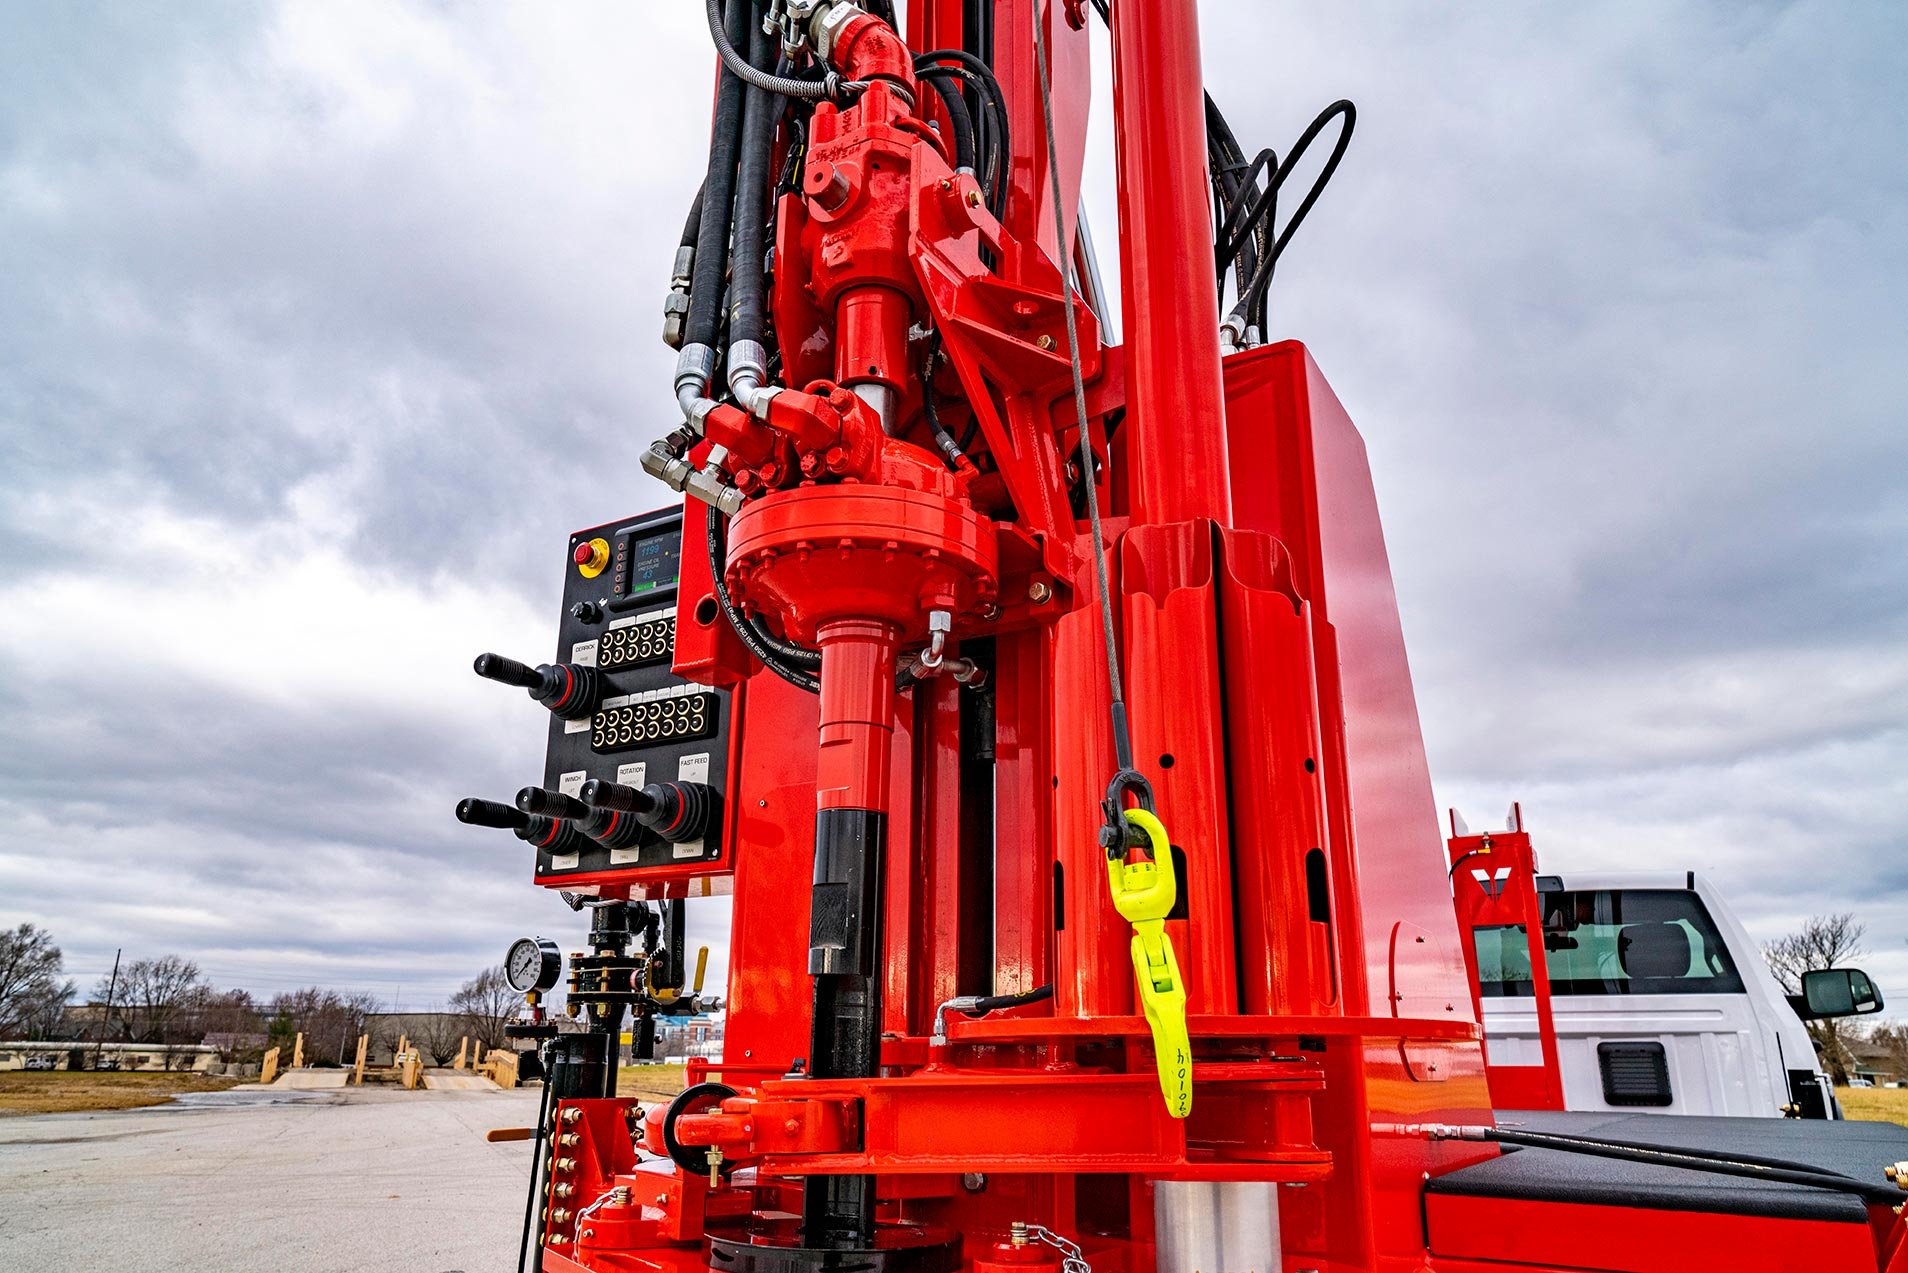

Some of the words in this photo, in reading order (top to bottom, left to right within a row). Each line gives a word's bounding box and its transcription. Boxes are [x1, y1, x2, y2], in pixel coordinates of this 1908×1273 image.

[641, 544, 660, 556] 1199
[745, 634, 756, 648] PSI
[754, 645, 767, 659] 4250
[680, 758, 694, 766] FAST
[694, 756, 708, 765] FEED
[619, 766, 644, 775] ROTATION
[565, 775, 581, 783] WINCH
